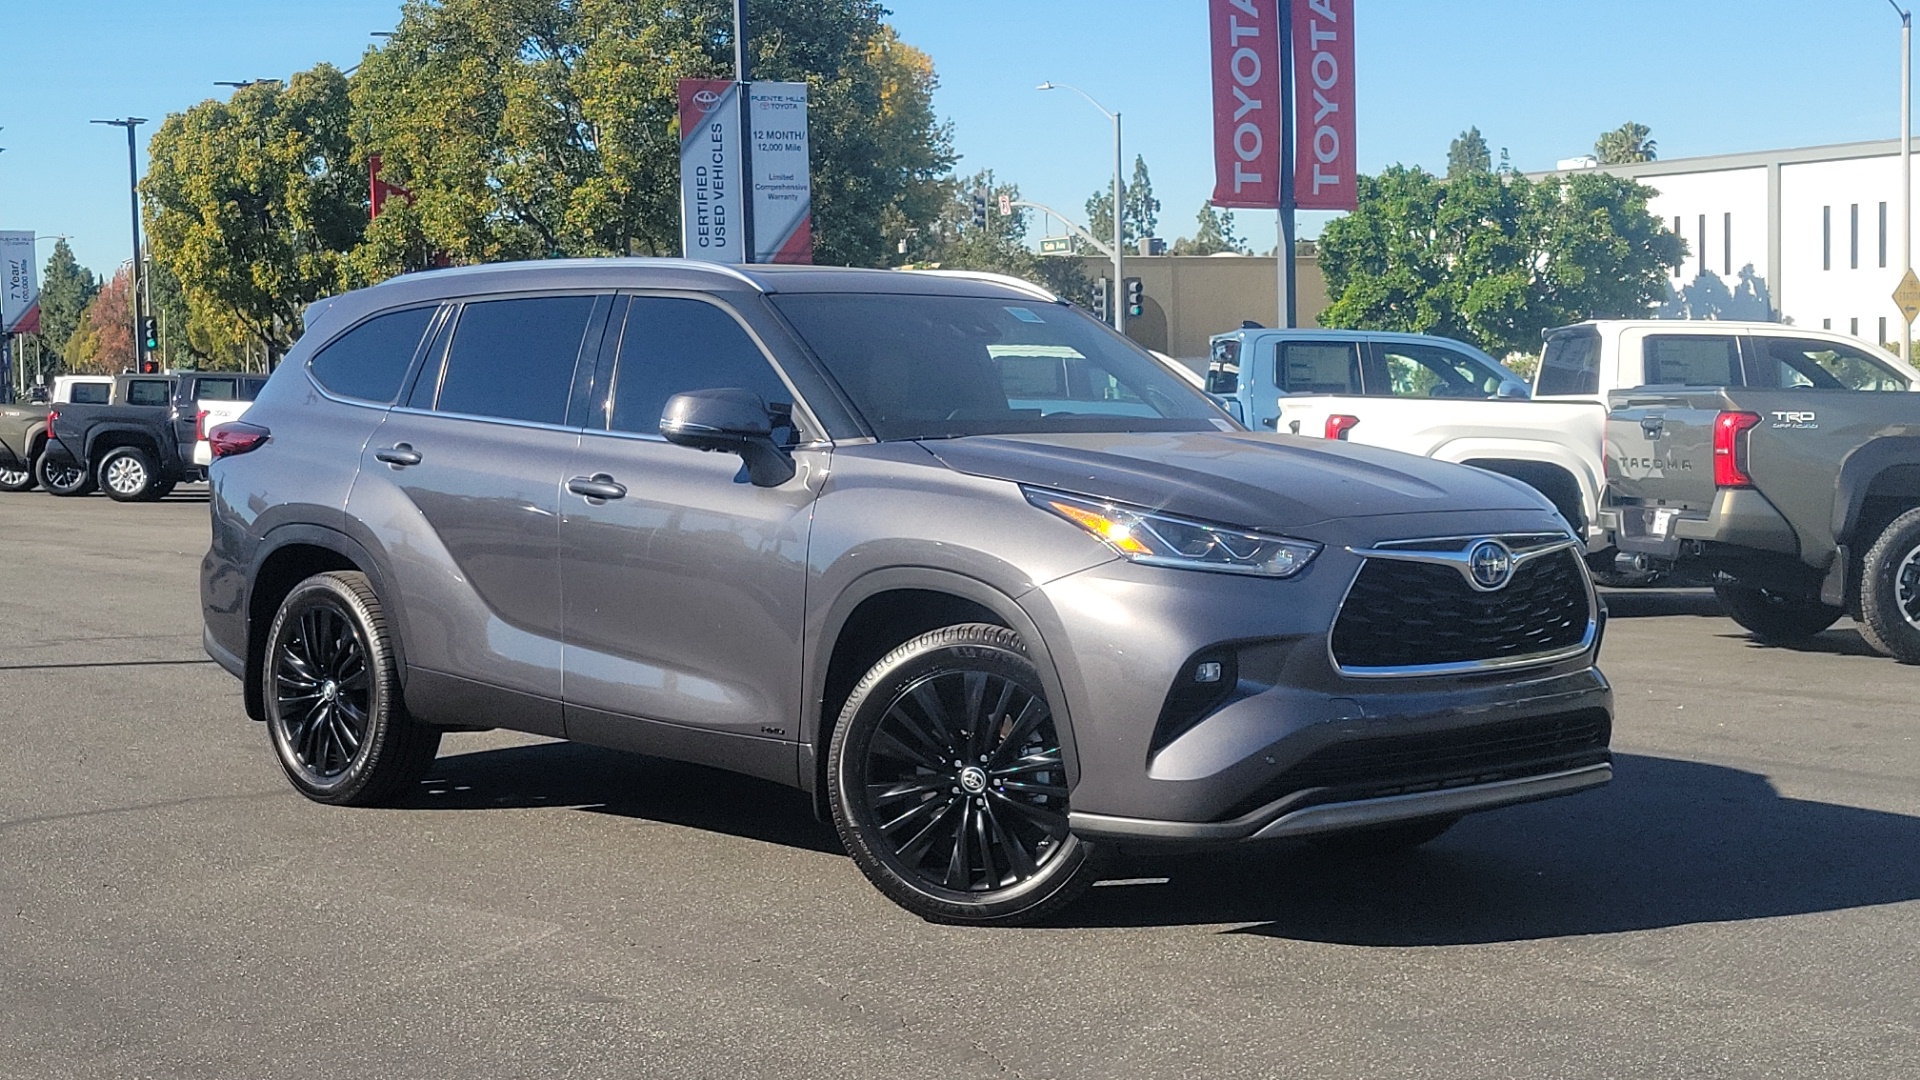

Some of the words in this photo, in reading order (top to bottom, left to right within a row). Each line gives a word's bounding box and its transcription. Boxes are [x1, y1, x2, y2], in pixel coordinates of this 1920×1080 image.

[1308, 0, 1340, 195] TOYOTA
[753, 131, 764, 139] 12
[766, 130, 805, 140] MONTH/
[758, 143, 783, 152] 12,000
[785, 143, 801, 151] Mile
[711, 123, 725, 200] VEHICLES
[754, 183, 808, 191] Comprehensive
[767, 193, 798, 201] Warranty
[696, 166, 710, 248] CERTIFIED
[714, 205, 727, 248] USED
[9, 259, 20, 291] Year/
[11, 293, 21, 301] 7
[1771, 411, 1816, 424] TRD
[1619, 456, 1693, 471] TACOMA
